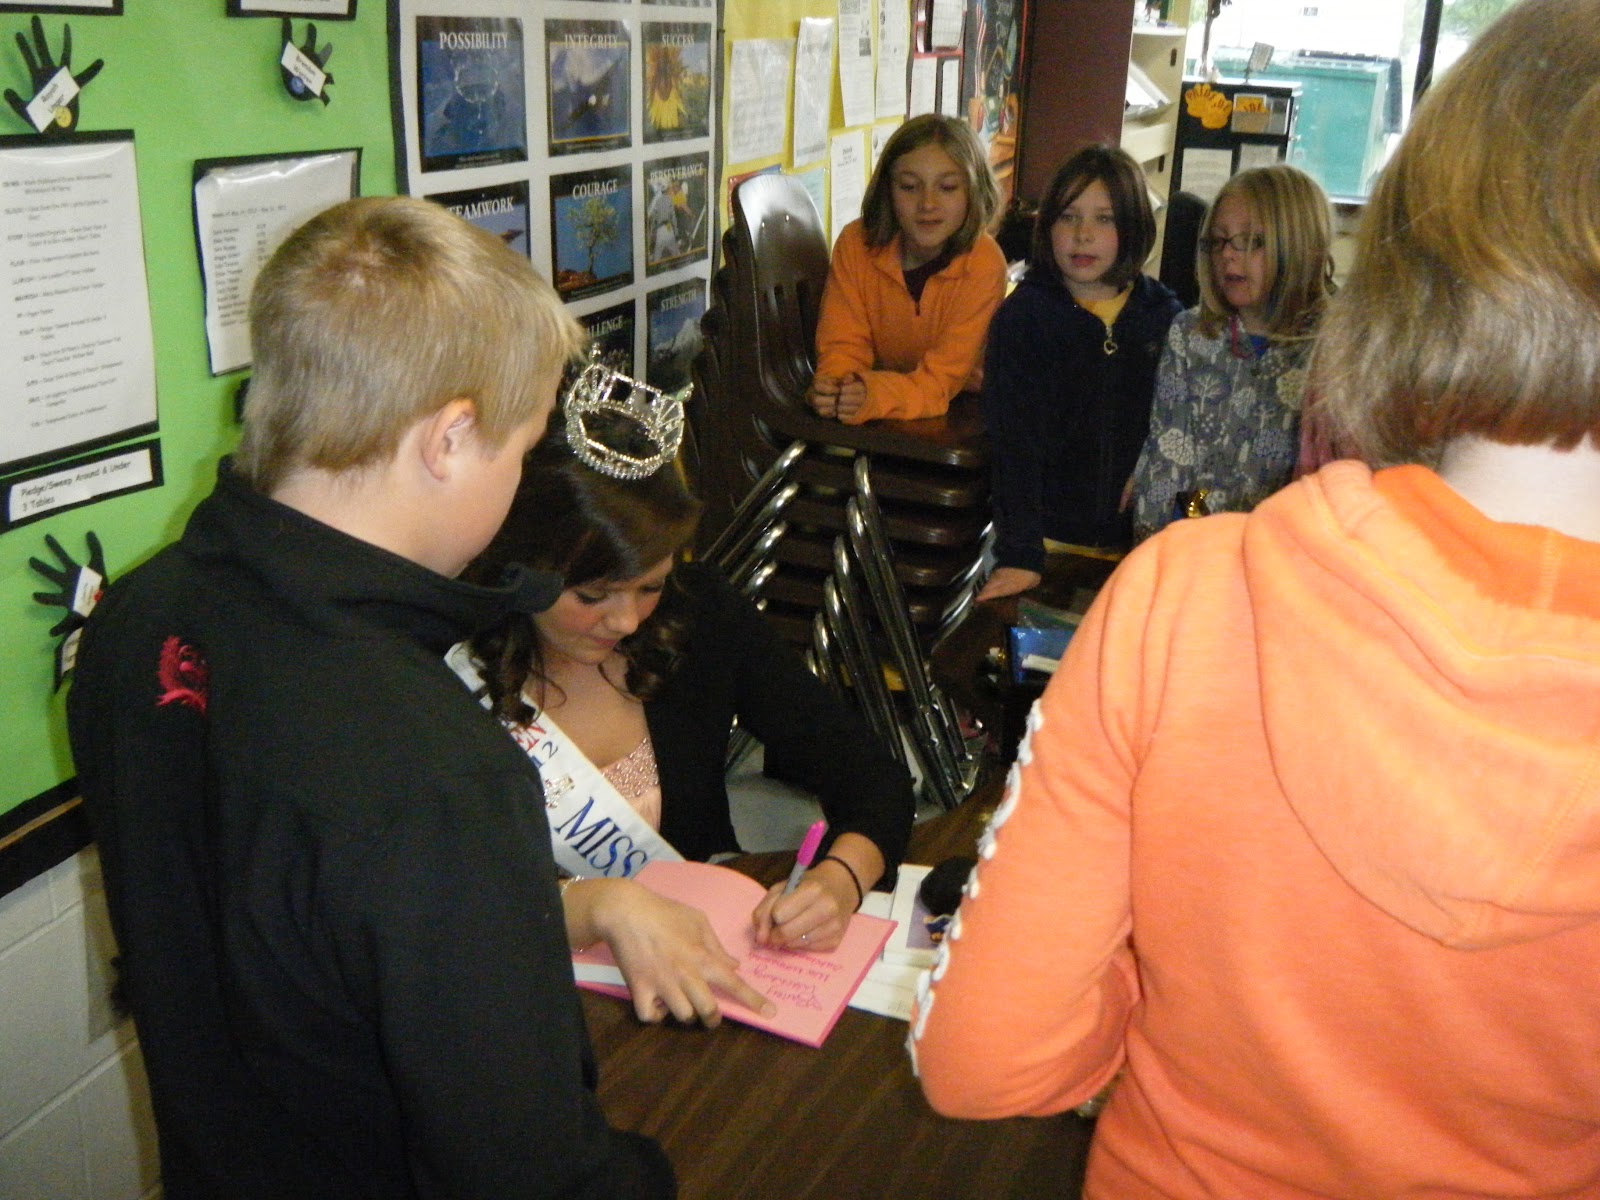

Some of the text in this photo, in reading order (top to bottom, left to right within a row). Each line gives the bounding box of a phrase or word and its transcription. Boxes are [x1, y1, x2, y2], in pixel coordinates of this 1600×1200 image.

[439, 31, 508, 50] POSSIBILITY
[563, 33, 620, 49] INTEGRITY
[661, 33, 696, 47] SUCCESS
[650, 161, 705, 182] PERSEVERANCE
[572, 178, 619, 200] COURAGE
[446, 196, 515, 221] TEAMWORK
[585, 314, 626, 339] ALLENGE
[554, 796, 648, 877] MISS
